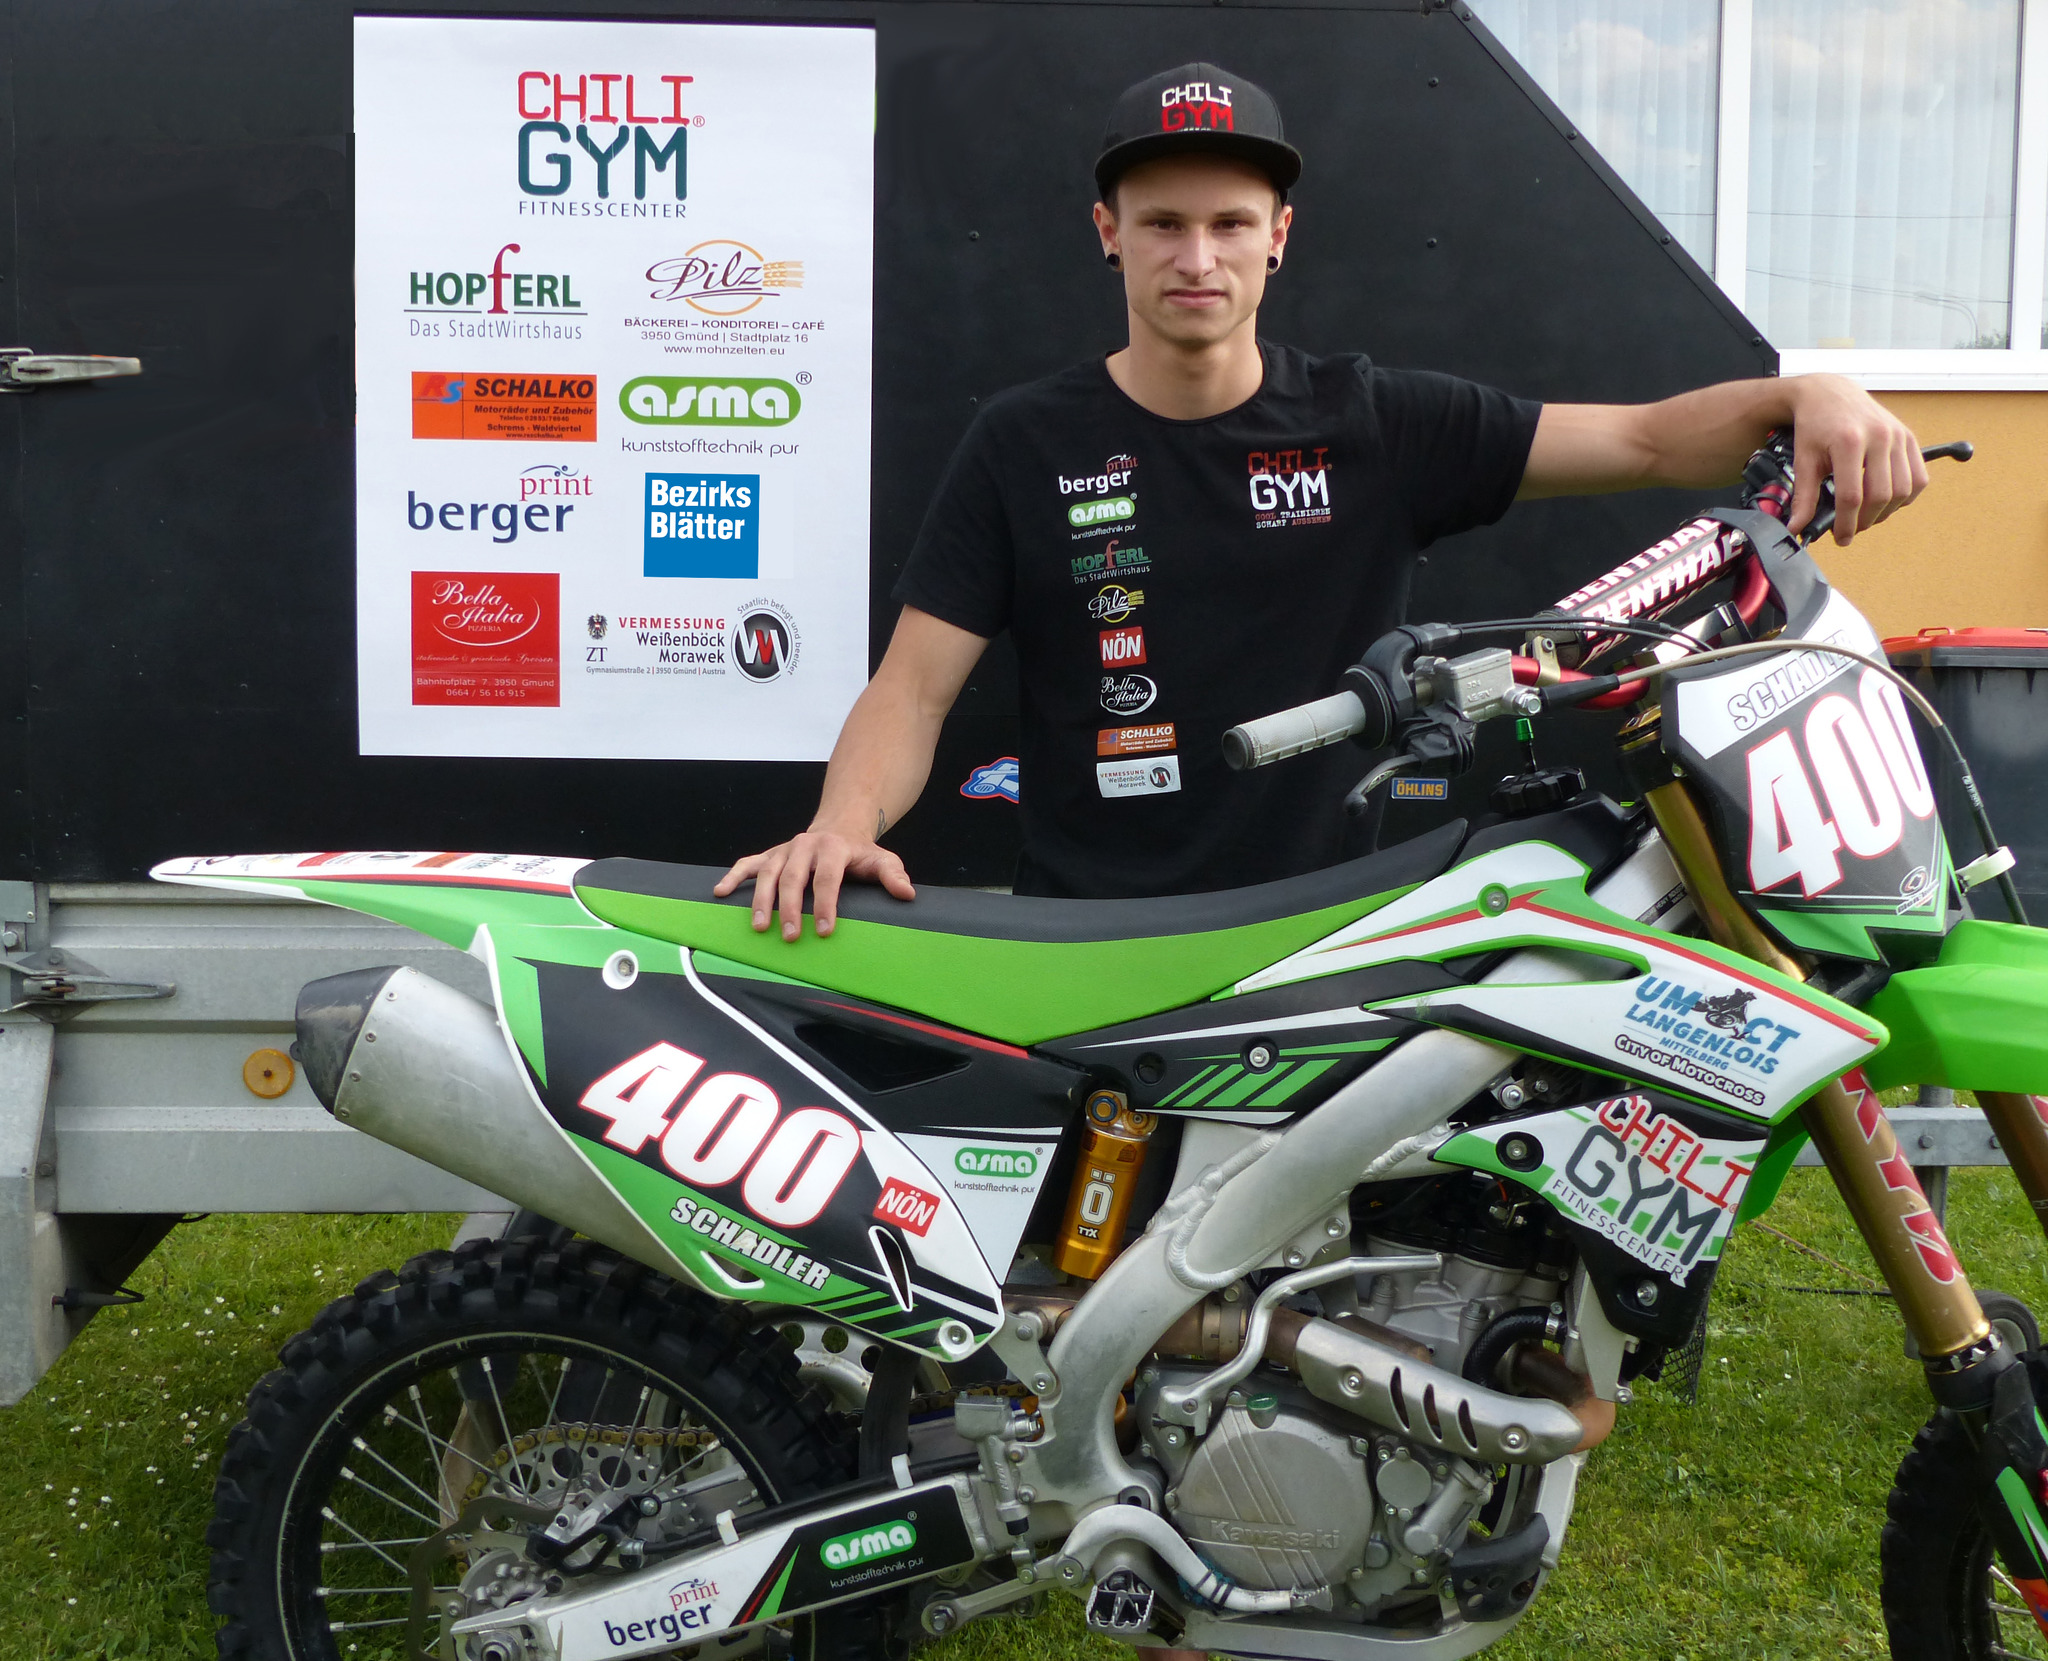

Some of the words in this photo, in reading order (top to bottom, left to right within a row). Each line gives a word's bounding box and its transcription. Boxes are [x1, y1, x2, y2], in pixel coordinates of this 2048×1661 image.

[518, 71, 694, 125] CHILI
[1161, 82, 1232, 108] CHILI
[1161, 99, 1234, 132] GYM
[518, 121, 688, 201] GYM
[518, 201, 687, 219] FITNESSCENTER
[645, 250, 763, 300] Pilz
[410, 319, 440, 337] Das
[449, 319, 582, 340] StadtWirtshaus
[624, 317, 689, 328] BÄCKEREI
[702, 320, 779, 330] KONDITOREI
[792, 319, 825, 331] CAFÉ
[641, 331, 671, 341] 3950
[674, 331, 719, 341] Gmünd
[730, 332, 791, 343] Stadtplatz
[794, 333, 809, 343] 16
[664, 344, 785, 355] www.mohnzelten.eu
[474, 378, 594, 399] SCHALKO
[474, 405, 529, 415] Motorräder
[532, 406, 550, 414] und
[552, 406, 594, 415] Zubehör
[628, 384, 790, 419] asma
[487, 424, 525, 432] Schrems
[532, 424, 582, 433] Waldviertel
[621, 437, 763, 454] kunststofftechnik
[769, 444, 799, 458] pur
[1106, 457, 1139, 475] print
[1247, 447, 1328, 475] CHILI
[519, 470, 593, 502] print
[651, 479, 751, 508] Bezirks
[1058, 470, 1132, 495] berger
[1249, 469, 1329, 511] GYM
[407, 490, 574, 543] berger
[1070, 500, 1131, 524] asma
[1255, 512, 1277, 521] COOL
[1256, 519, 1287, 529] SCHARF
[650, 511, 745, 540] Blätter
[1124, 524, 1137, 534] pur
[1074, 575, 1088, 585] Das
[1089, 565, 1151, 582] StadtWirtshaus
[432, 580, 502, 605] Bella
[443, 603, 525, 629] Italia
[618, 617, 725, 630] VERMESSUNG
[737, 597, 769, 615] Staatlich
[770, 599, 794, 623] befugt
[791, 622, 802, 640] und
[636, 632, 725, 647] Weißenböck
[1102, 632, 1141, 662] NÖN
[586, 647, 608, 662] ZT
[659, 648, 726, 664] Morawek
[416, 677, 476, 687] Bahnhofplatz
[494, 678, 517, 687] 3950
[586, 665, 645, 675] Gymnasiumstraße
[656, 667, 672, 675] 3950
[673, 666, 697, 675] Gmünd
[702, 667, 726, 676] Austria
[446, 689, 469, 697] 0664
[479, 689, 491, 697] 56
[494, 689, 505, 697] 16
[508, 689, 526, 698] 915
[1101, 676, 1136, 694] Bella
[1120, 726, 1173, 739] SCHALKO
[1100, 769, 1144, 778] VERMESSUNG
[1745, 666, 1935, 900] 400
[1396, 779, 1444, 796] ÖHLINS
[1624, 1004, 1780, 1075] LANGENLOIS
[1658, 1037, 1729, 1071] MITTELBERG
[1615, 1034, 1650, 1058] CITY
[1671, 1053, 1766, 1107] MOTOCROSS
[577, 1039, 863, 1229] 400
[959, 1151, 1033, 1175] asma
[1599, 1095, 1752, 1209] CHILI
[954, 1180, 1019, 1193] kunststofftechnik
[1021, 1186, 1035, 1195] pur
[1565, 1124, 1722, 1266] GYM
[878, 1187, 935, 1227] NÖN
[1078, 1226, 1099, 1239] TTX
[1552, 1178, 1685, 1281] FITNESSCENTER
[669, 1196, 832, 1291] SCHADLER
[824, 1525, 913, 1565] asma
[1210, 1518, 1340, 1549] Kawasaki
[829, 1561, 906, 1590] kunststofftechnik
[907, 1556, 924, 1572] pur
[669, 1580, 720, 1612] print
[605, 1600, 713, 1647] berger
